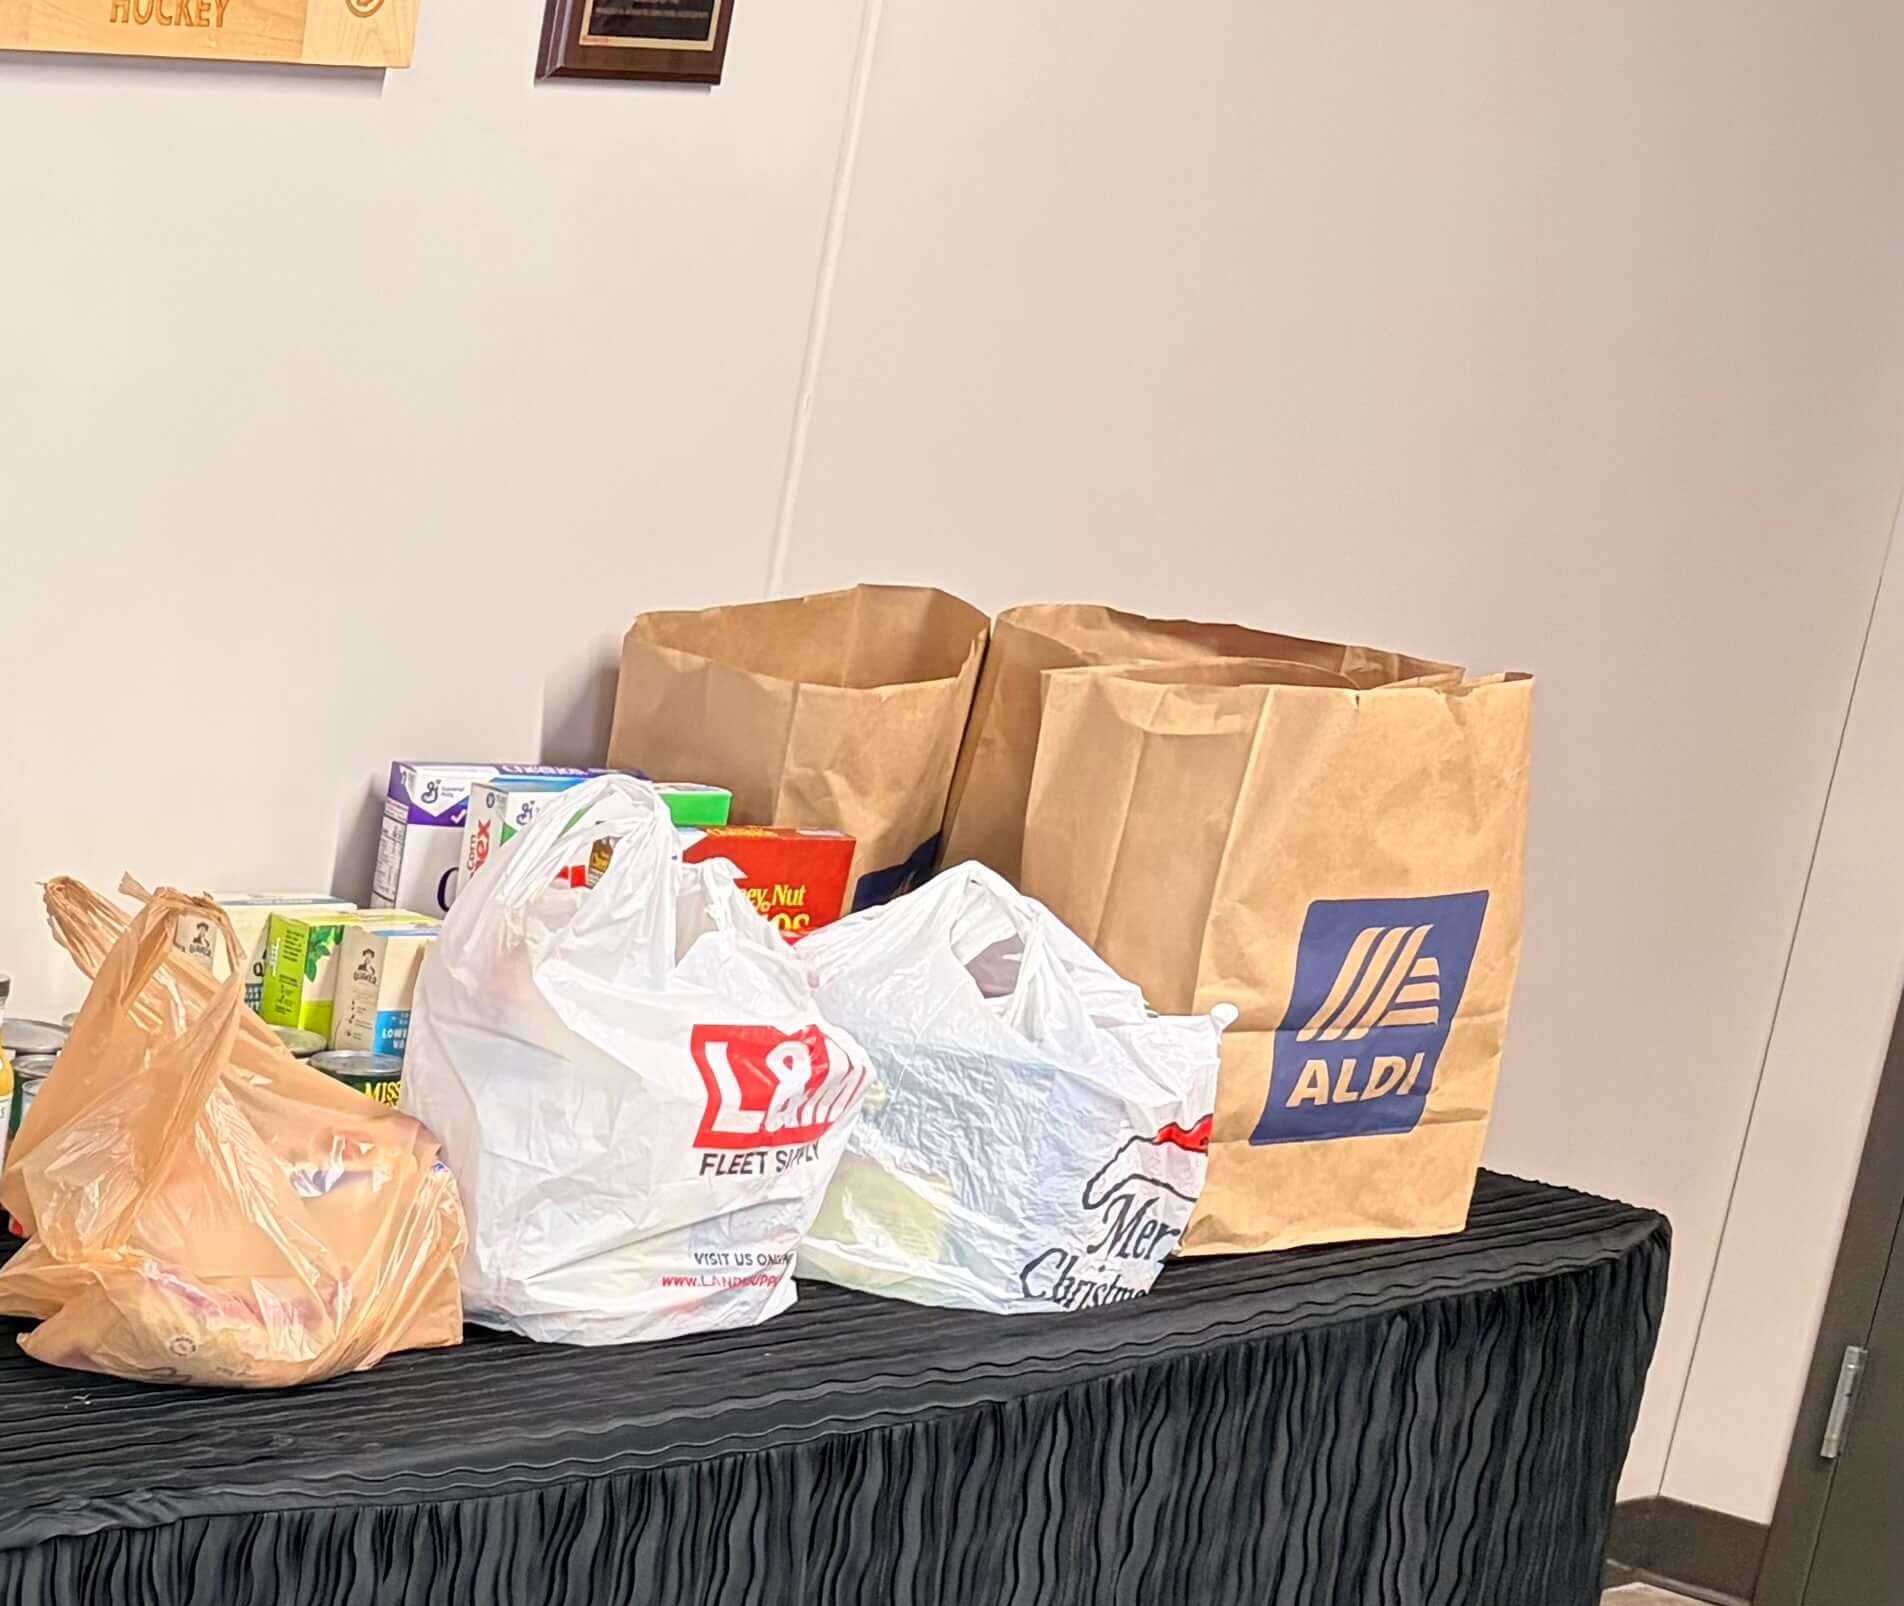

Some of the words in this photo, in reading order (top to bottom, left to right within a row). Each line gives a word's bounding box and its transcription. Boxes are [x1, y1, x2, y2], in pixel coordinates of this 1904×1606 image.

[109, 0, 229, 28] HOCKEY
[773, 884, 806, 906] Nut
[1286, 1052, 1425, 1107] ALDI
[699, 1151, 768, 1176] FLEET
[694, 1253, 729, 1266] VISIT
[736, 1254, 753, 1265] US
